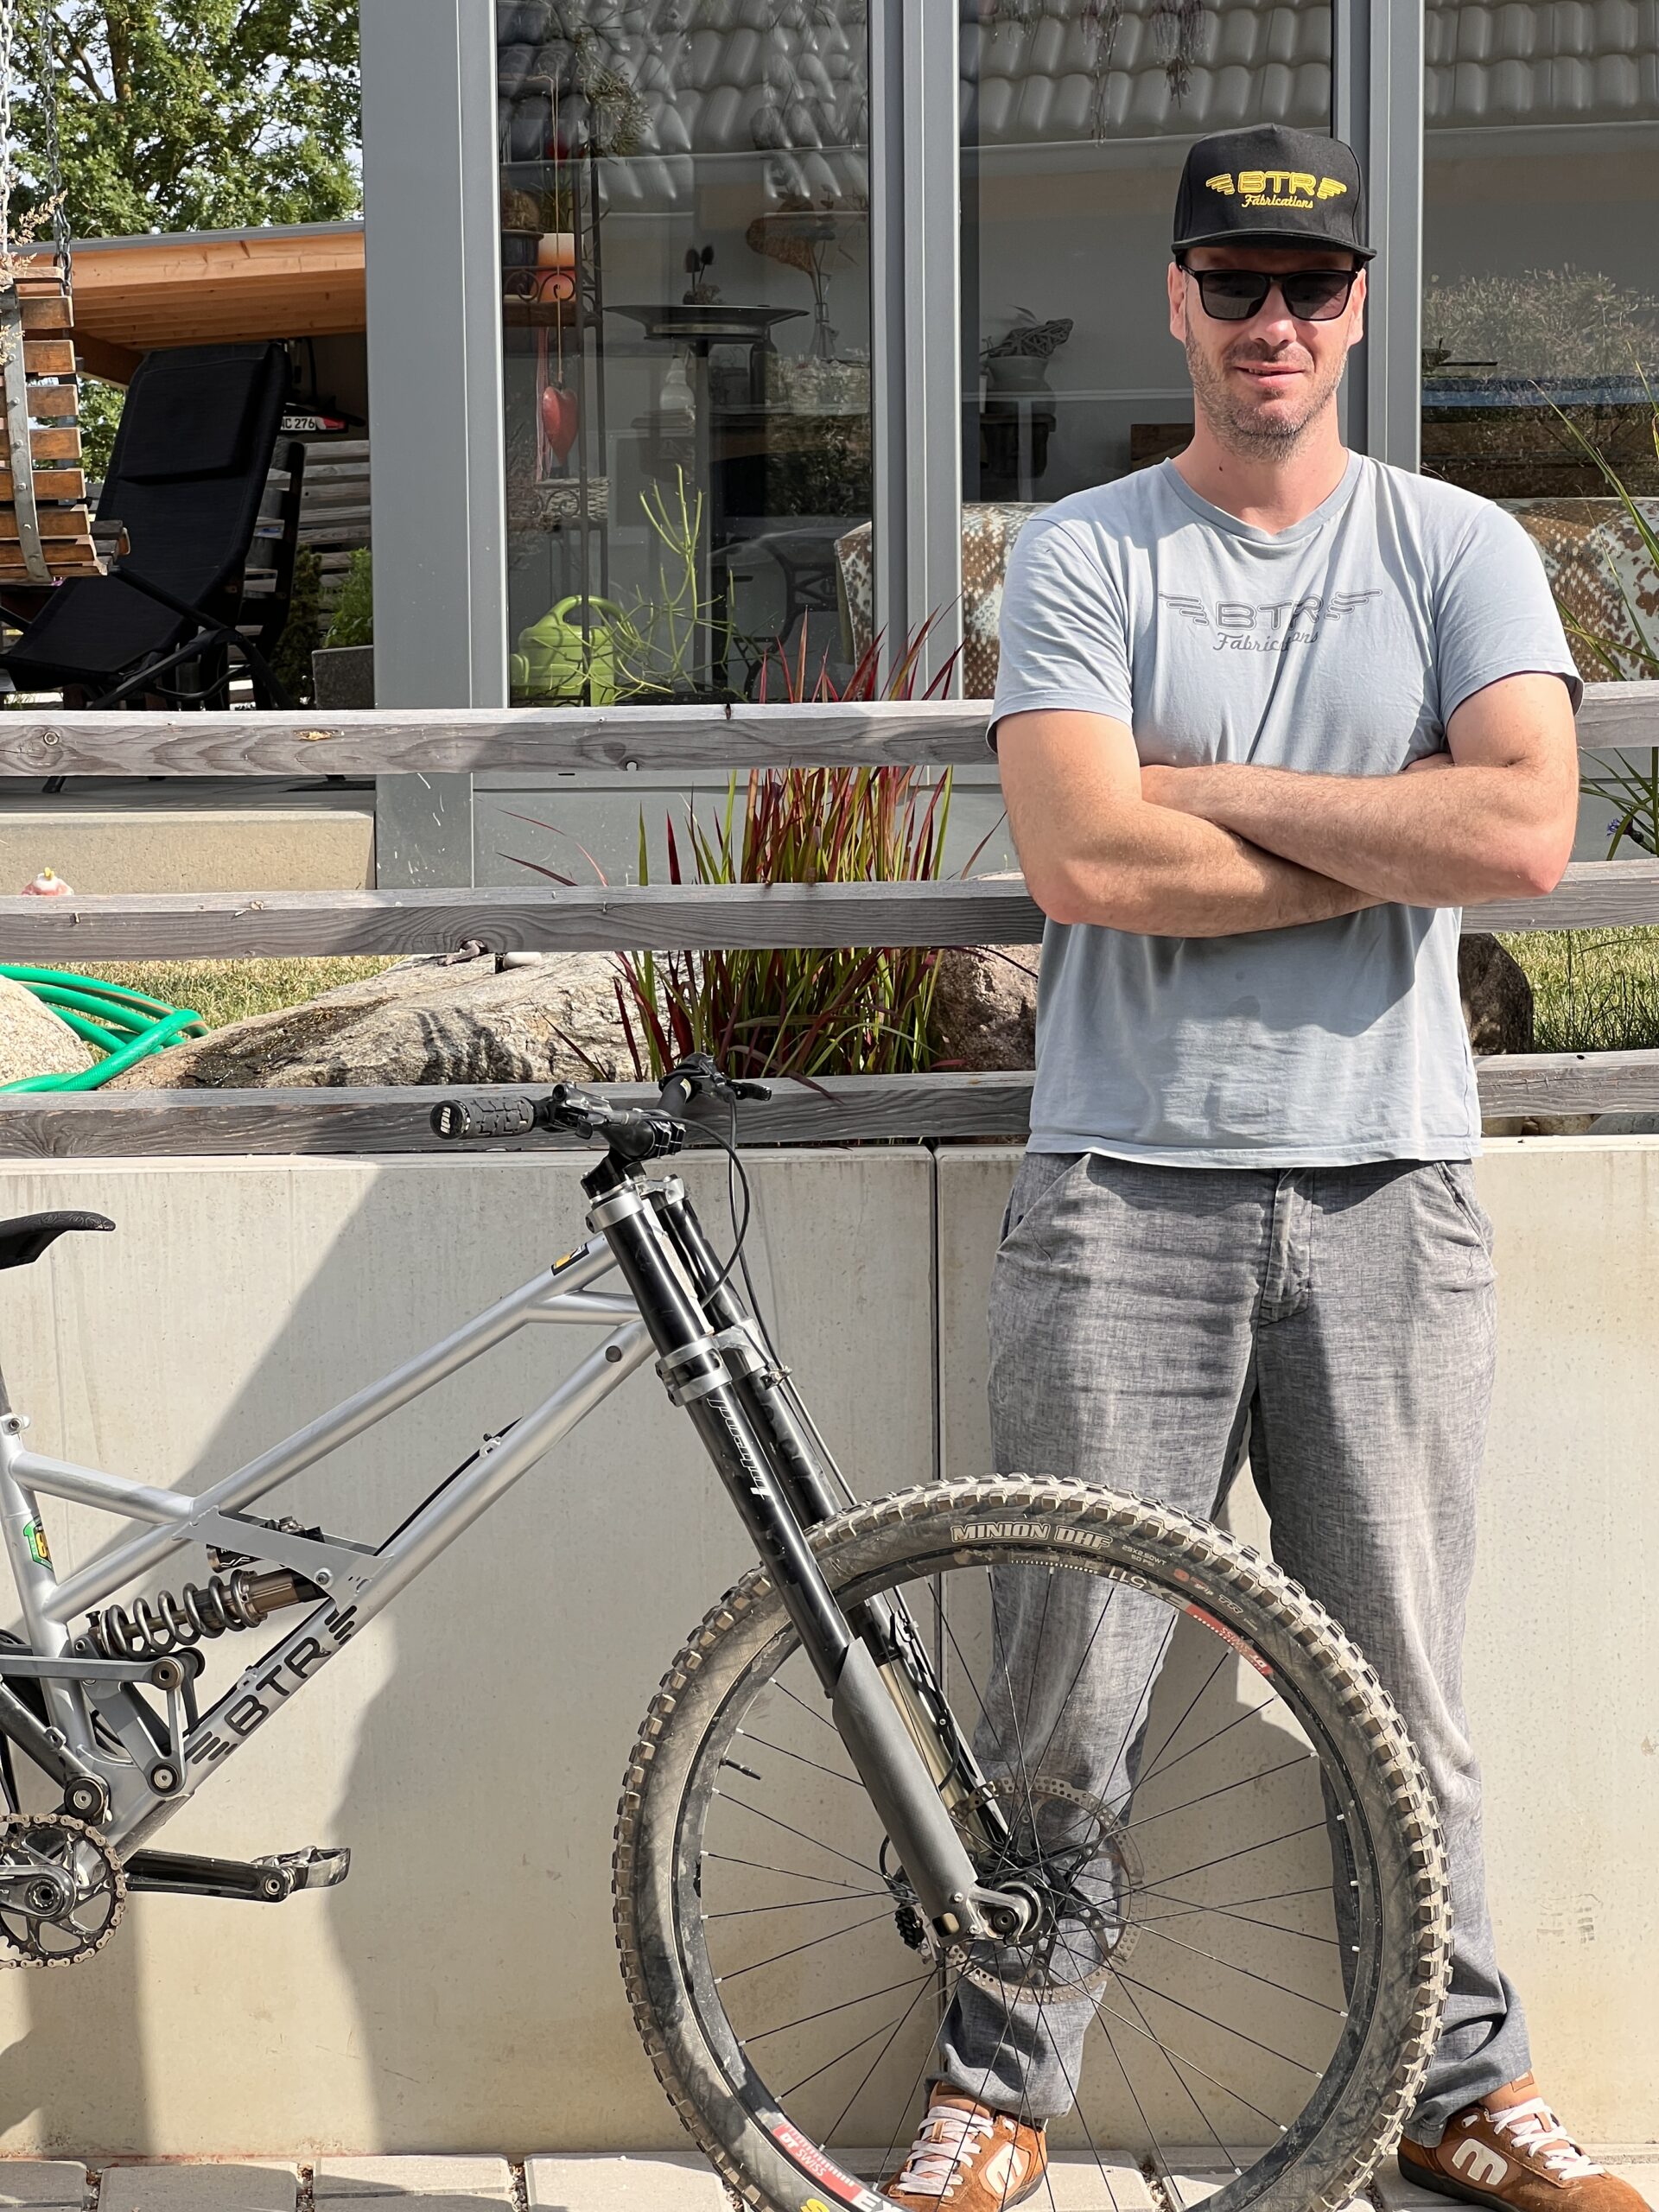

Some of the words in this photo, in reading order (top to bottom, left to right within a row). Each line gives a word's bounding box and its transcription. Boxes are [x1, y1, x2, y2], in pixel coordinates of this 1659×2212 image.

[1237, 170, 1317, 196] BTR
[1241, 194, 1314, 209] Fabrications
[295, 417, 315, 429] 276
[1216, 595, 1324, 631] BTR
[950, 1521, 1051, 1542] MINION
[1054, 1524, 1113, 1550] DHF
[224, 1637, 332, 1737] BTR
[779, 2131, 800, 2150] DT
[795, 2149, 828, 2177] SWISS
